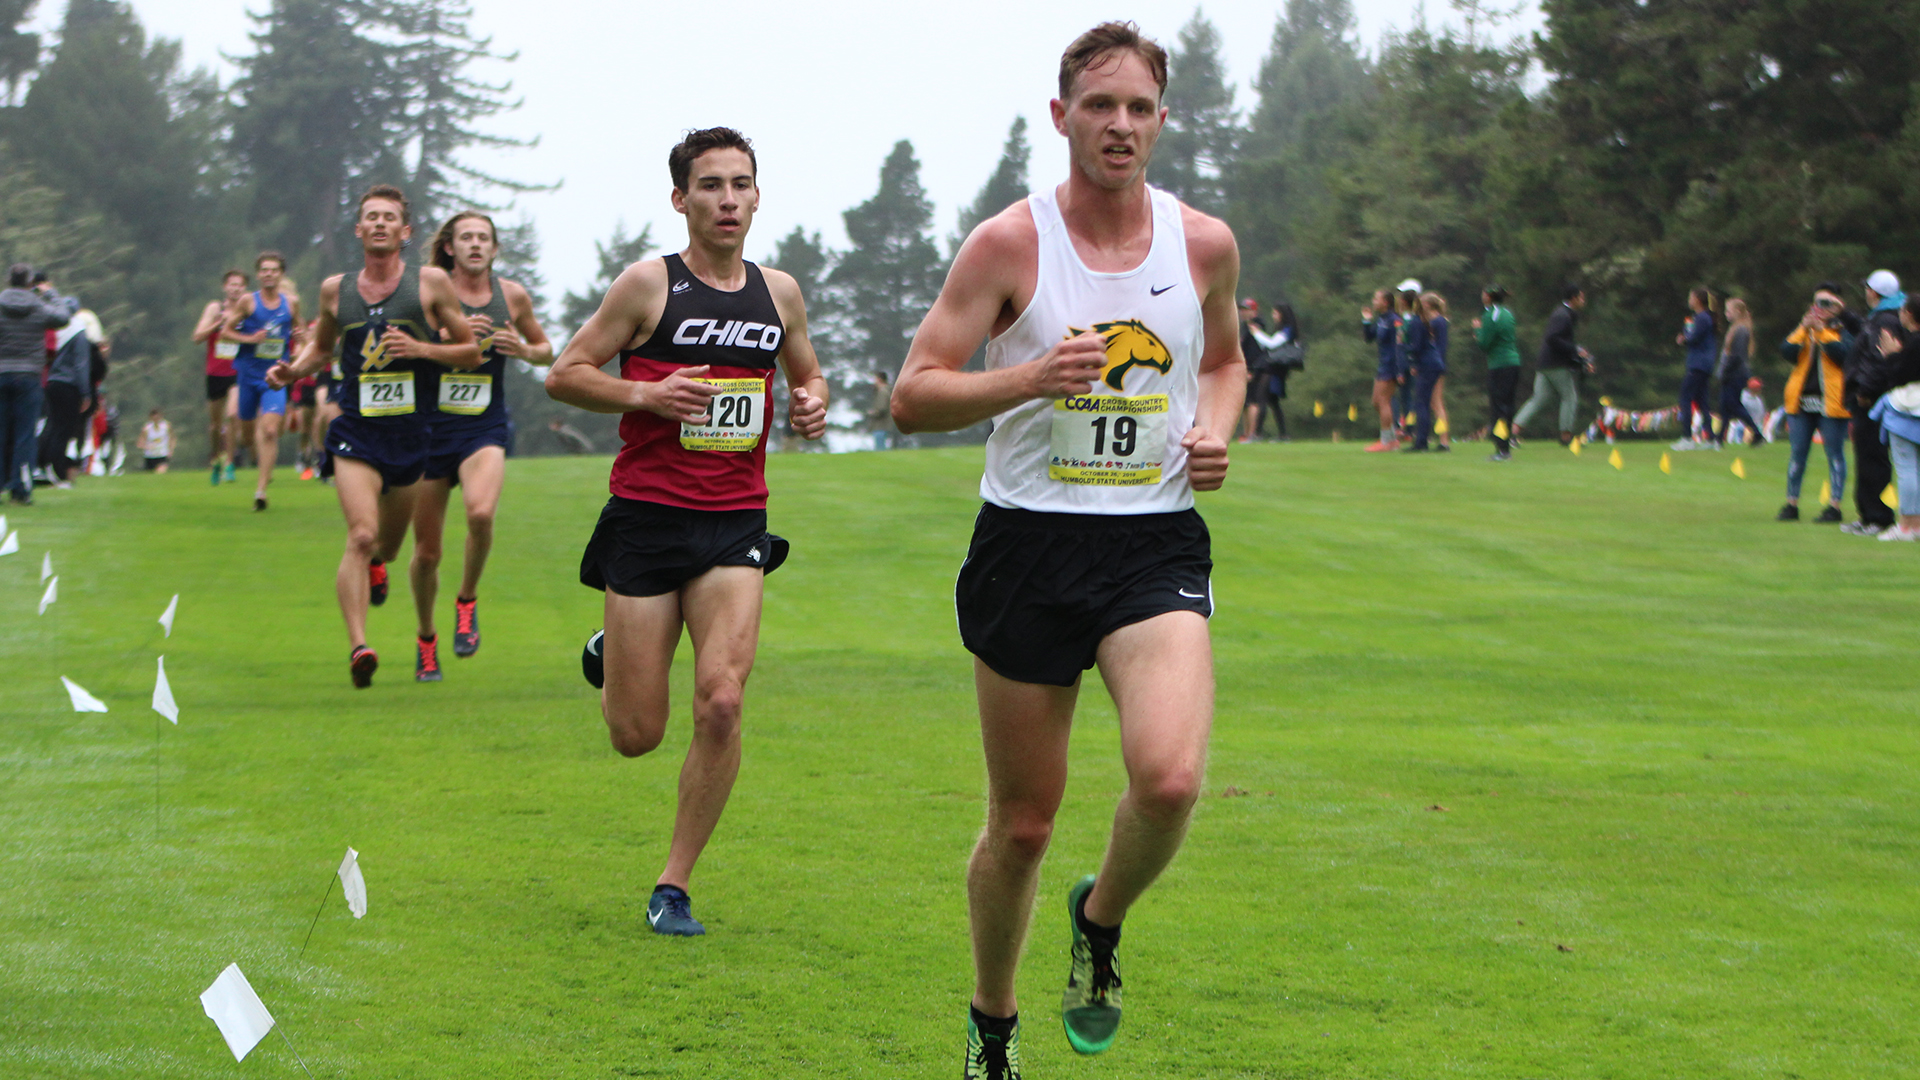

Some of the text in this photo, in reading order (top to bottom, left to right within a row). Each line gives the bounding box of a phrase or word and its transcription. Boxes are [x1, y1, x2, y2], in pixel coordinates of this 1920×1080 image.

[673, 318, 781, 351] CHICO
[371, 383, 404, 402] 224
[450, 384, 481, 402] 227
[1065, 396, 1101, 412] CCAA
[1100, 404, 1163, 414] CHAMPIONSHIPS
[1101, 398, 1163, 407] CROSS COUNTRY
[1091, 416, 1137, 457] 19
[1061, 477, 1095, 485] HUMBOLDT
[1118, 477, 1151, 486] UNIVERSITY
